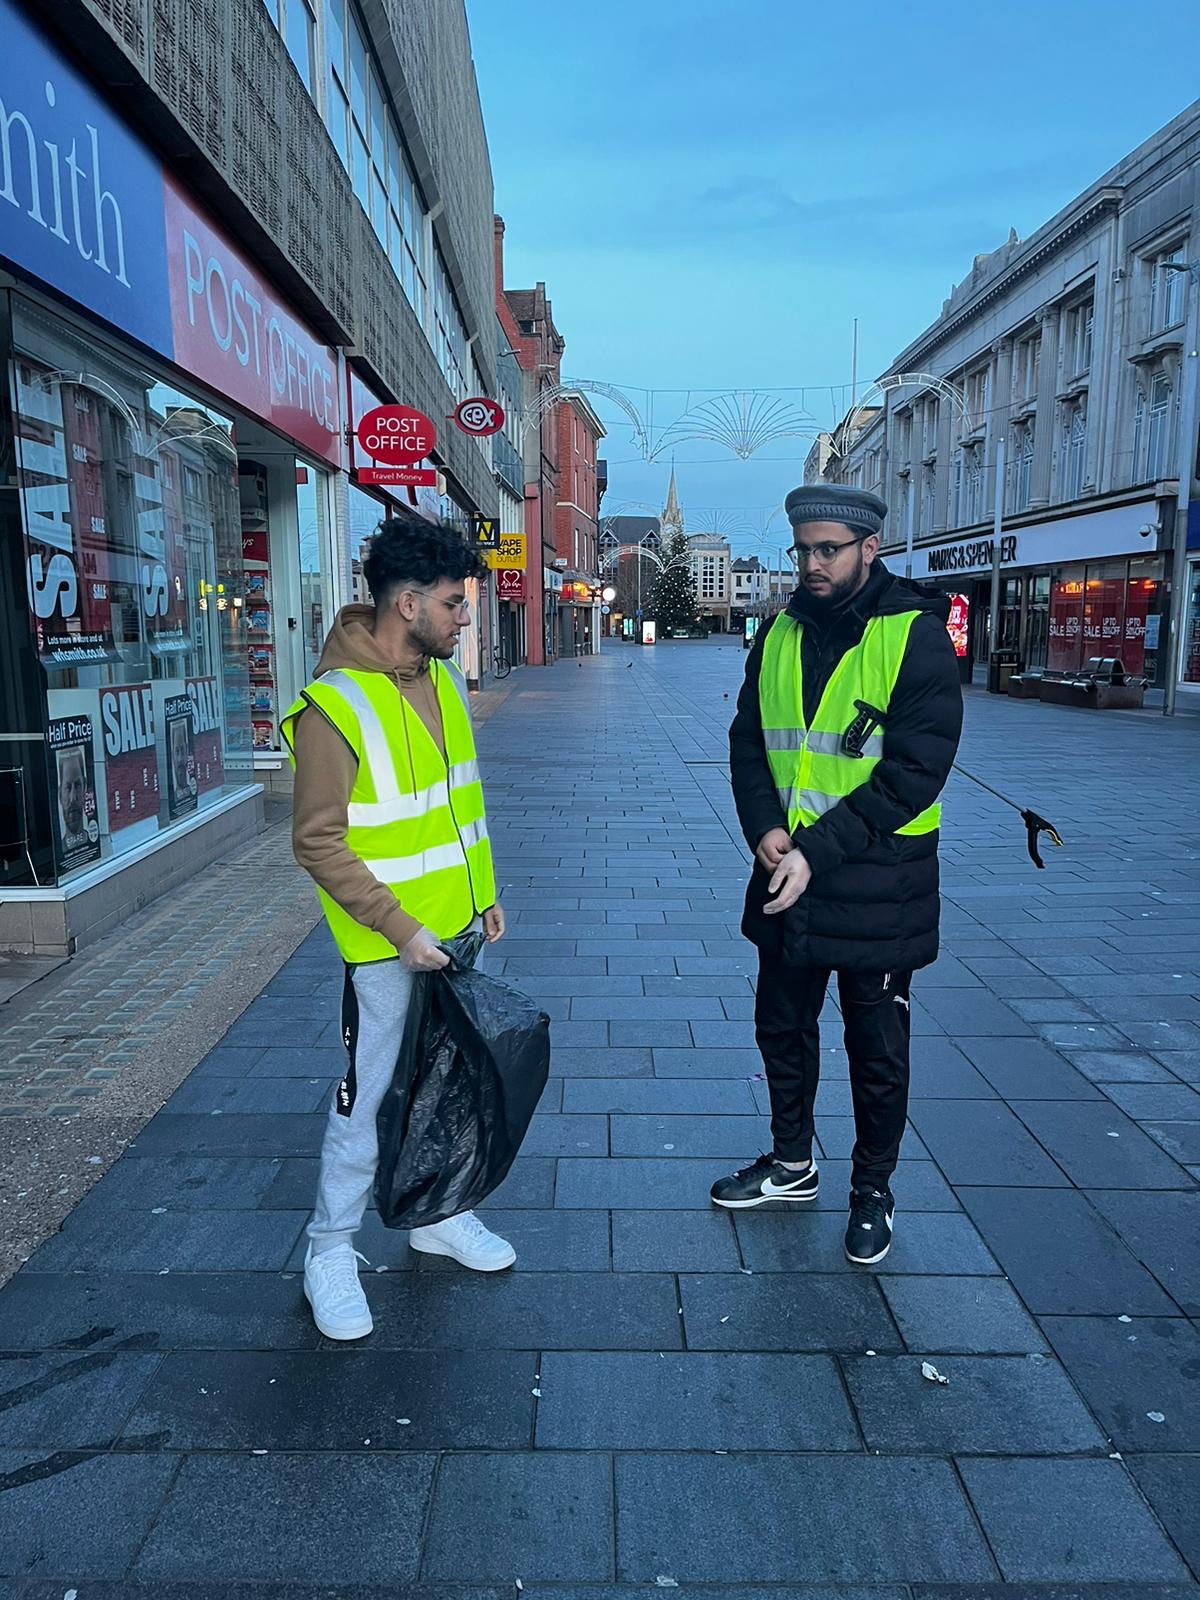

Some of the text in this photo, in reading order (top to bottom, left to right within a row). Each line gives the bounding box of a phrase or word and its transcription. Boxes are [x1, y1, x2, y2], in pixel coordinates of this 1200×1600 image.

[184, 229, 334, 433] POST OFFICE
[376, 417, 420, 433] POST
[365, 435, 426, 451] OFFICE
[372, 472, 423, 481] Travel Money
[9, 359, 77, 618] SALE
[497, 548, 522, 556] SHOP
[1049, 625, 1064, 637] SALE
[1083, 625, 1101, 637] SALE
[52, 645, 108, 661] whsmith.co.uk
[102, 688, 155, 756] SALE
[49, 720, 91, 742] Half Price
